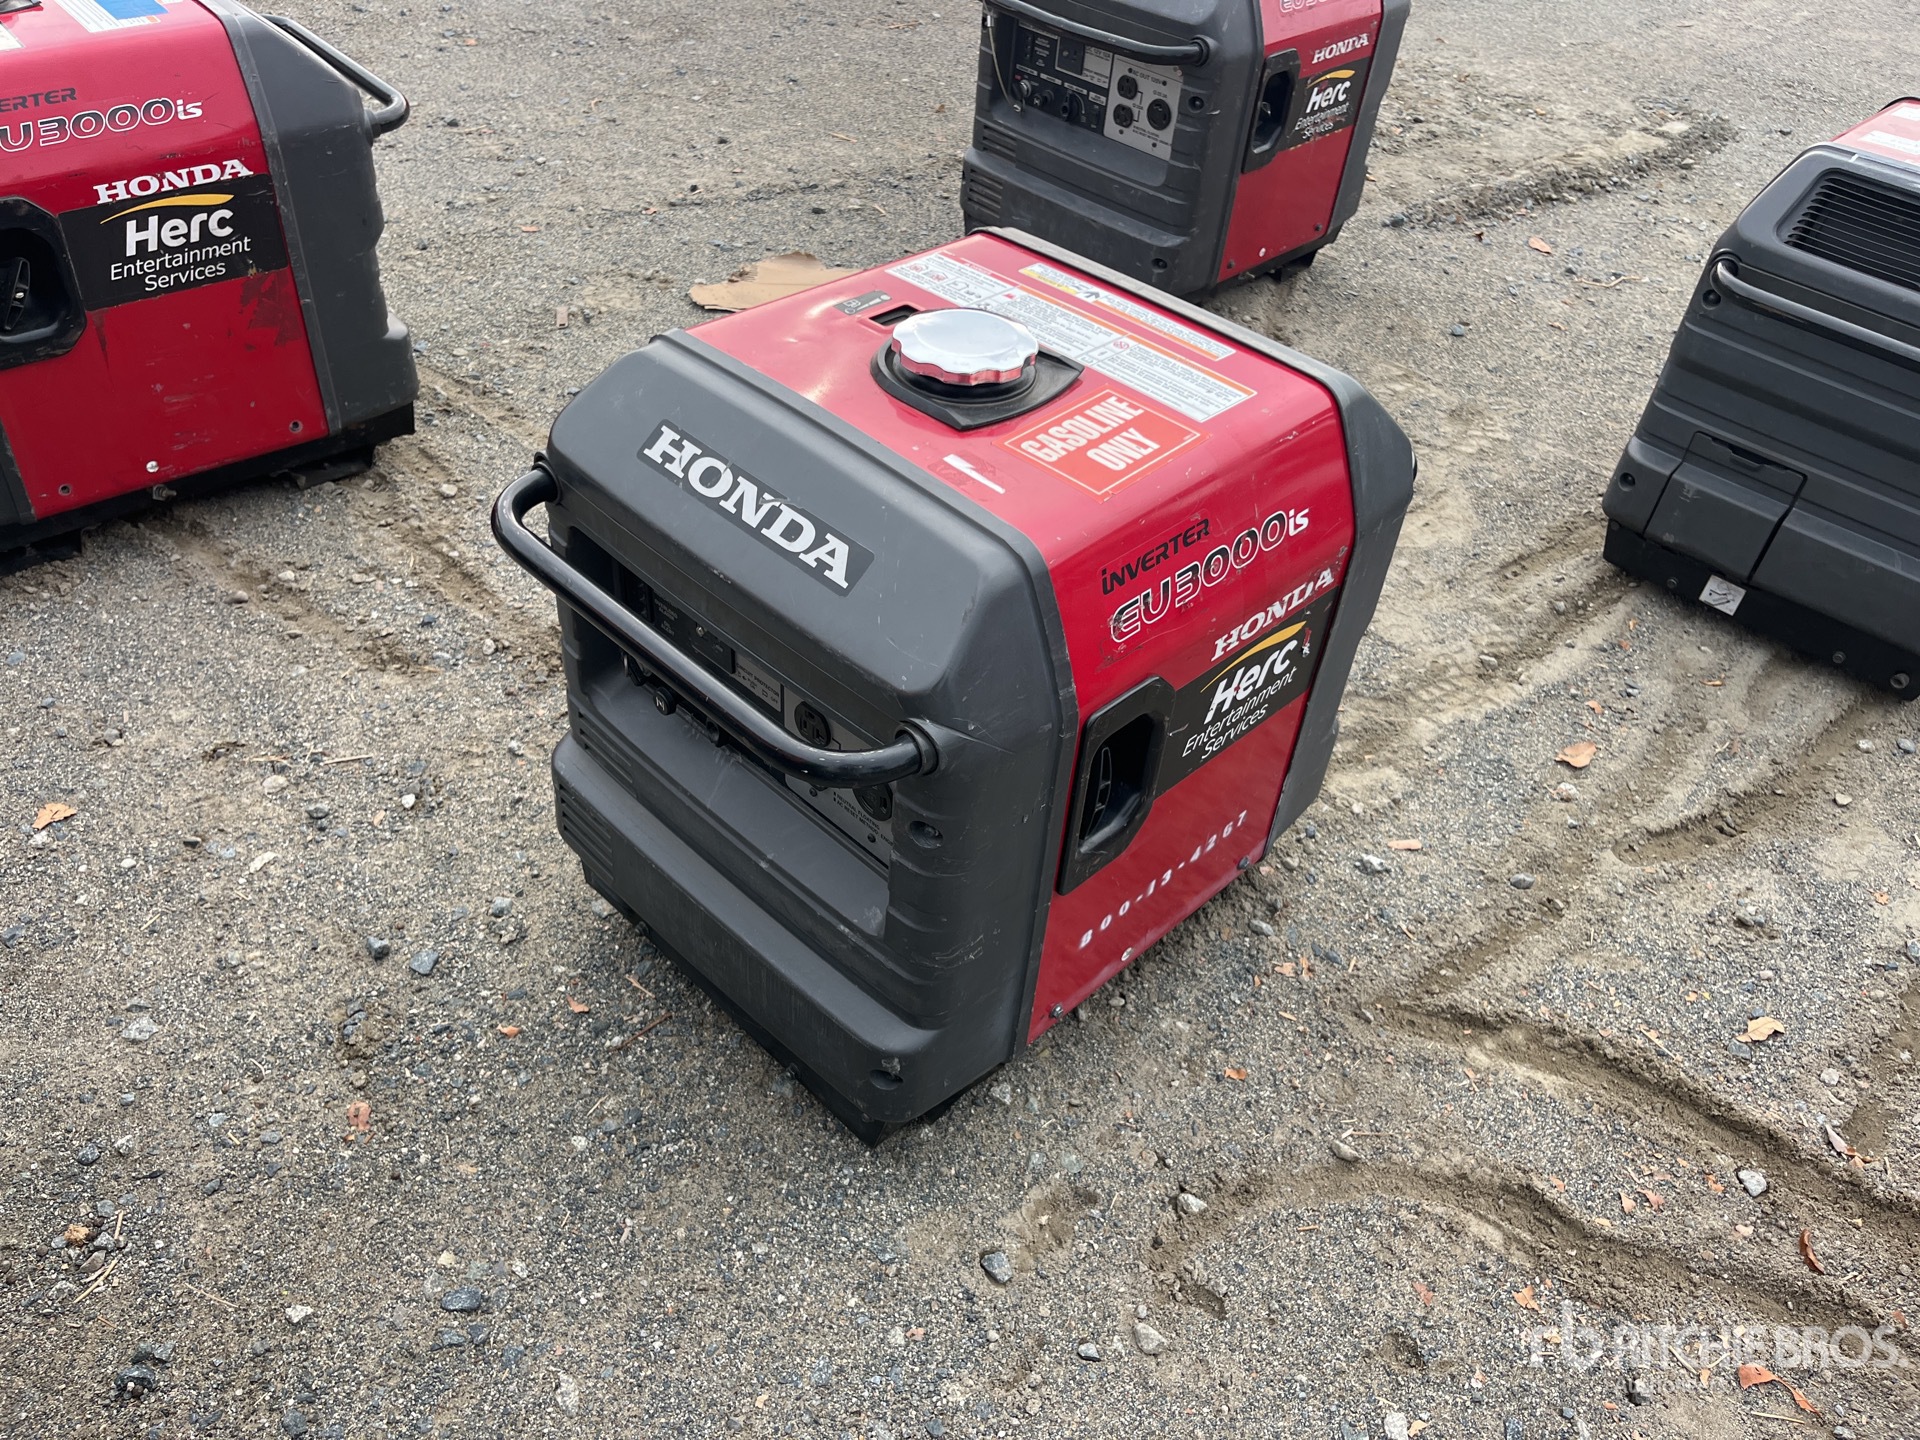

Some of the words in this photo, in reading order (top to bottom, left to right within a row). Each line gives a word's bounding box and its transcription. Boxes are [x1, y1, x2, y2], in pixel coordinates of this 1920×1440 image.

[1312, 33, 1369, 64] HONDA
[1294, 102, 1350, 130] Entertainment
[1305, 81, 1351, 113] Herc
[1302, 122, 1334, 139] Services
[92, 158, 253, 204] HONDA
[124, 207, 234, 257] Herc
[110, 236, 251, 281] Entertainment
[144, 261, 226, 292] Services
[1020, 396, 1144, 463] GASOLINE
[1086, 427, 1161, 472] ONLY
[643, 425, 850, 590] HONDA
[1110, 507, 1310, 644] EU3000is
[1211, 567, 1335, 662] HONDA
[753, 676, 780, 697] PROTECTOR
[1204, 639, 1298, 725] Herc
[1181, 666, 1298, 758] Entertainment
[1201, 704, 1269, 760] Services
[836, 793, 858, 812] NEUTRAL
[858, 809, 881, 830] FLOATING
